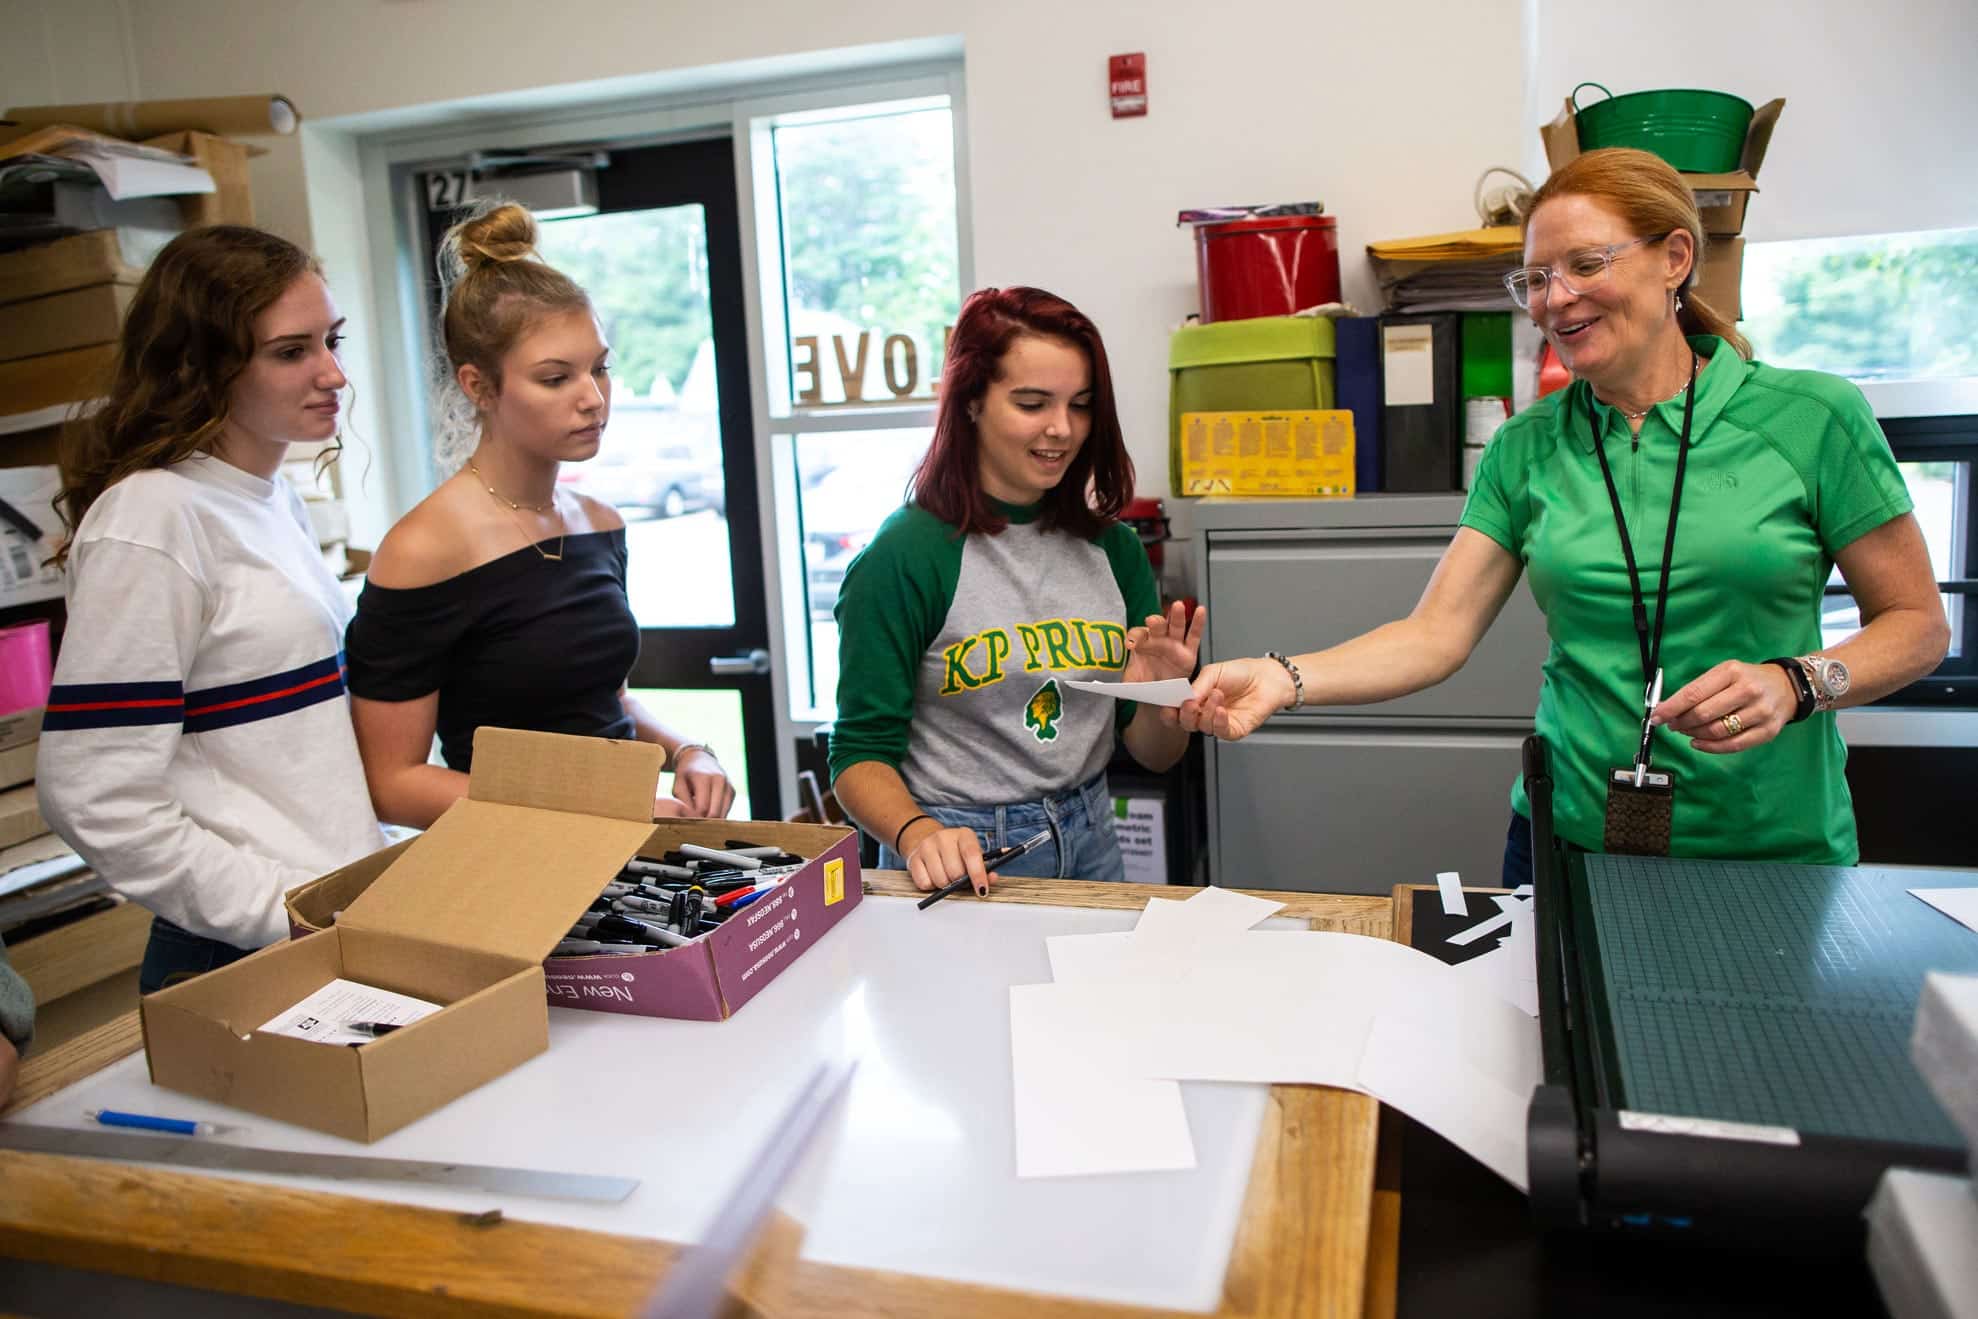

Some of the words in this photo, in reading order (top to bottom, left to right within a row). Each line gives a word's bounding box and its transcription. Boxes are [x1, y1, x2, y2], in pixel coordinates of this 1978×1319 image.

[1111, 80, 1141, 94] FIRE
[432, 172, 465, 205] 27
[940, 627, 1010, 695] KP
[1014, 617, 1127, 671] PRID
[545, 984, 580, 999] En
[583, 985, 634, 1001] New
